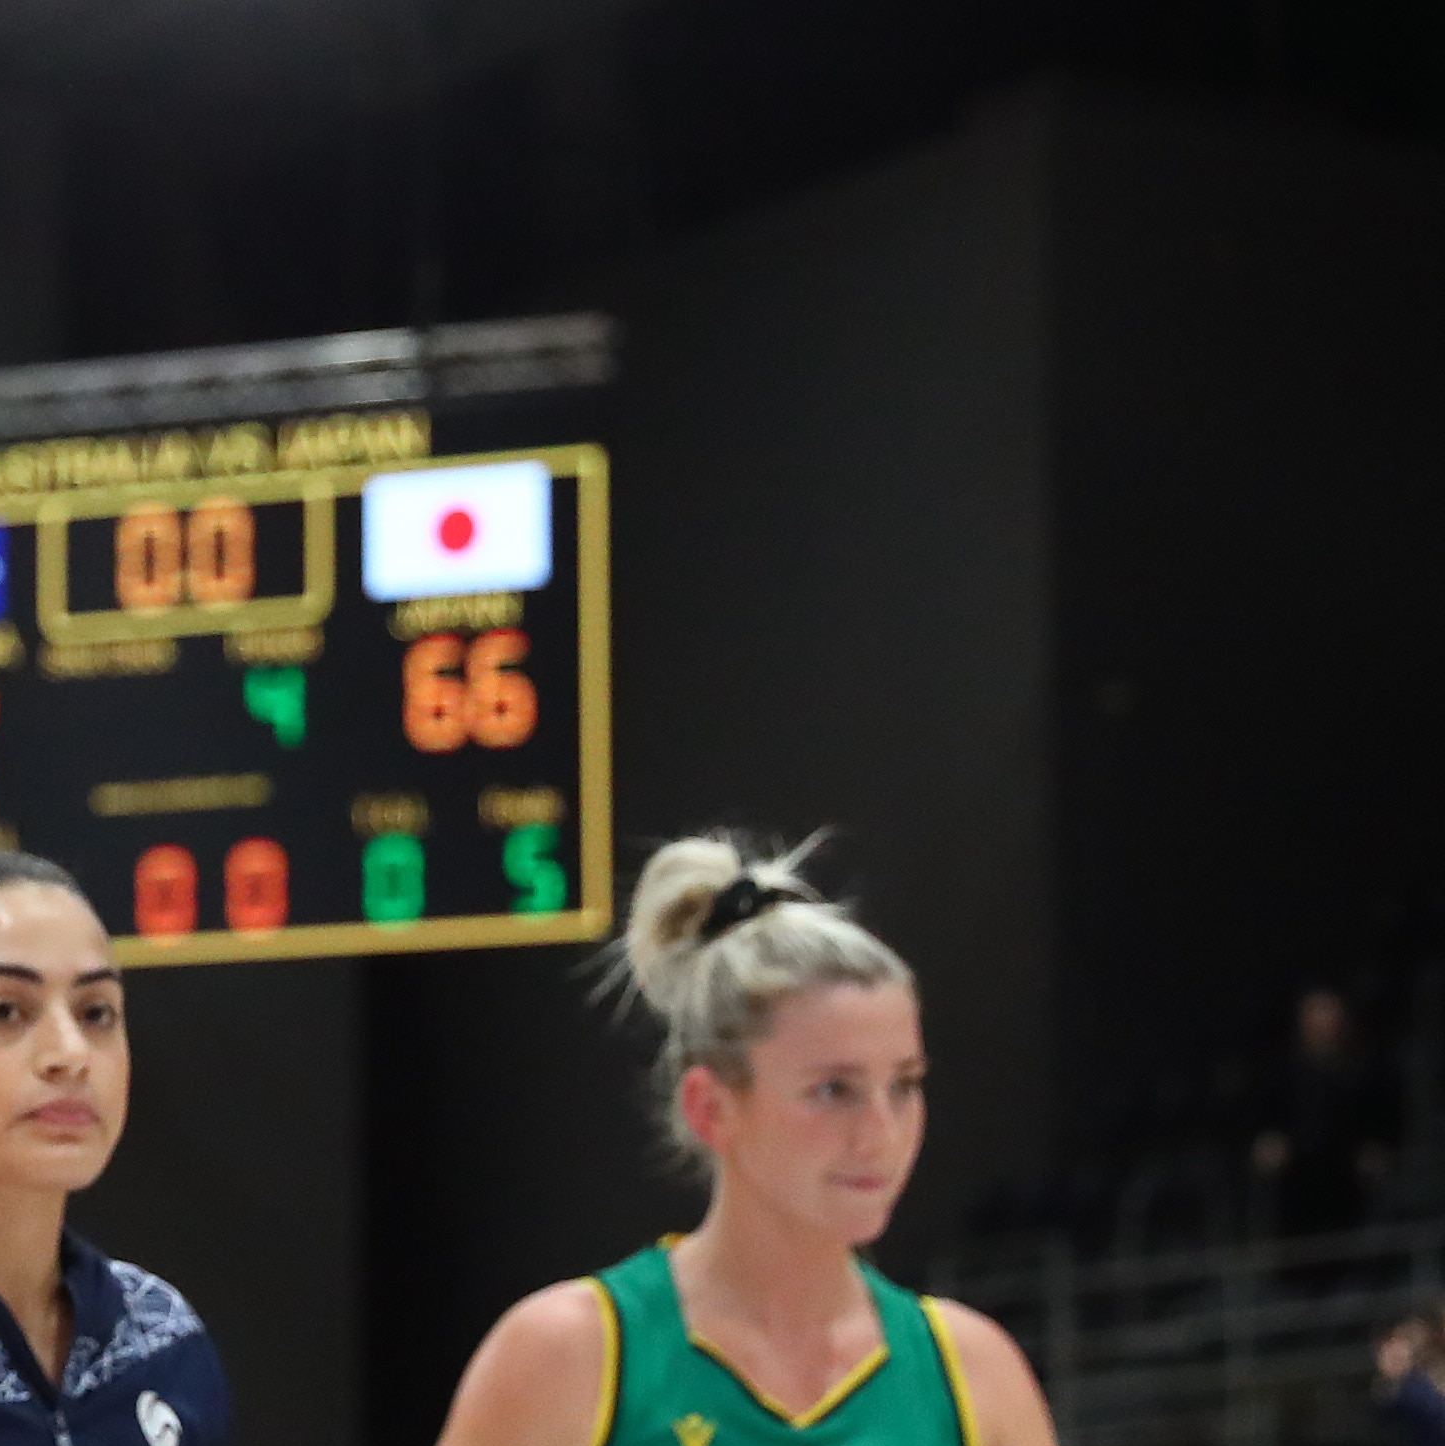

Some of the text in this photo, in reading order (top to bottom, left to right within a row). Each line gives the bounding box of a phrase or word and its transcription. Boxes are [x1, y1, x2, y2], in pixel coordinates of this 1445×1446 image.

[113, 498, 256, 618] 00
[401, 627, 539, 755] 66
[360, 831, 427, 931] 0
